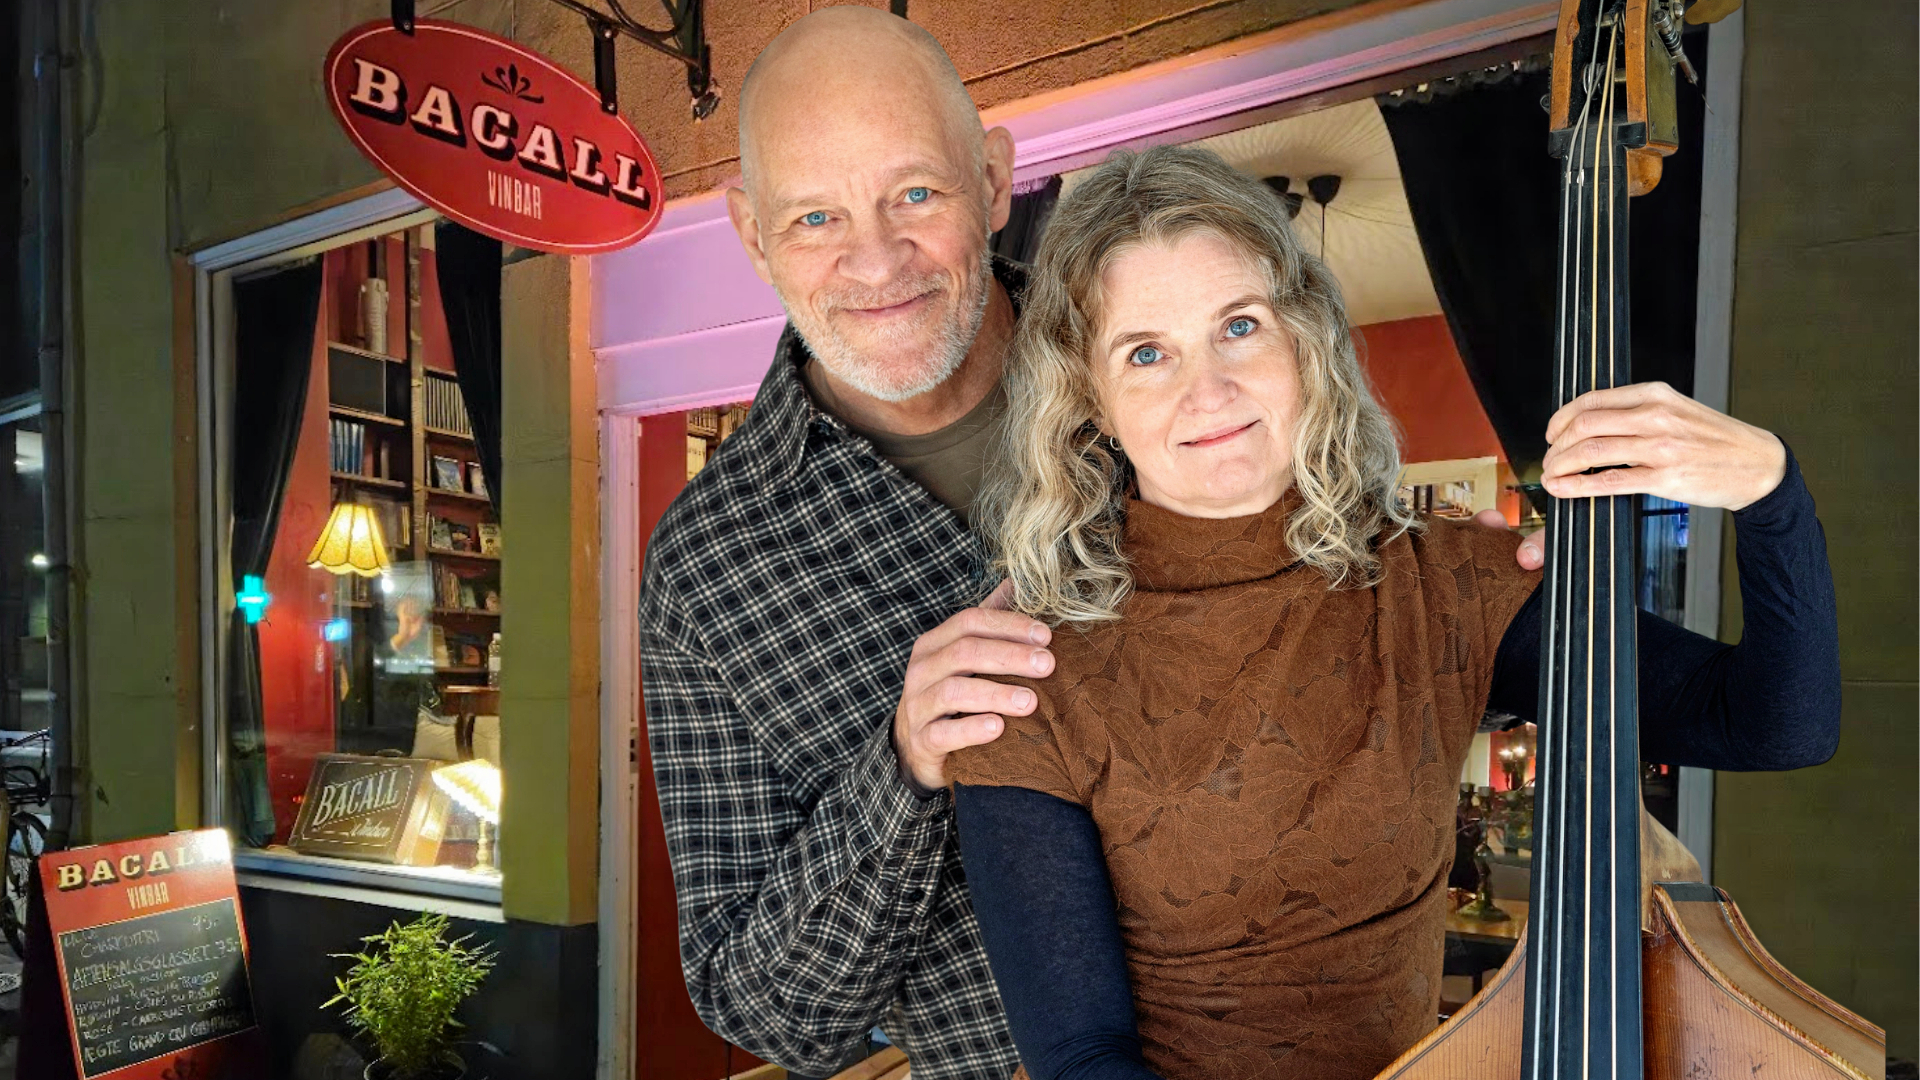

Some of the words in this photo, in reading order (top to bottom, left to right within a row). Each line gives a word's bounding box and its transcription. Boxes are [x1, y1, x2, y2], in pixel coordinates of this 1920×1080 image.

[349, 57, 649, 208] BACALL
[487, 169, 543, 221] VINBAR
[311, 769, 399, 828] BACALL
[57, 845, 228, 891] BACAL
[127, 881, 170, 911] VINBAR
